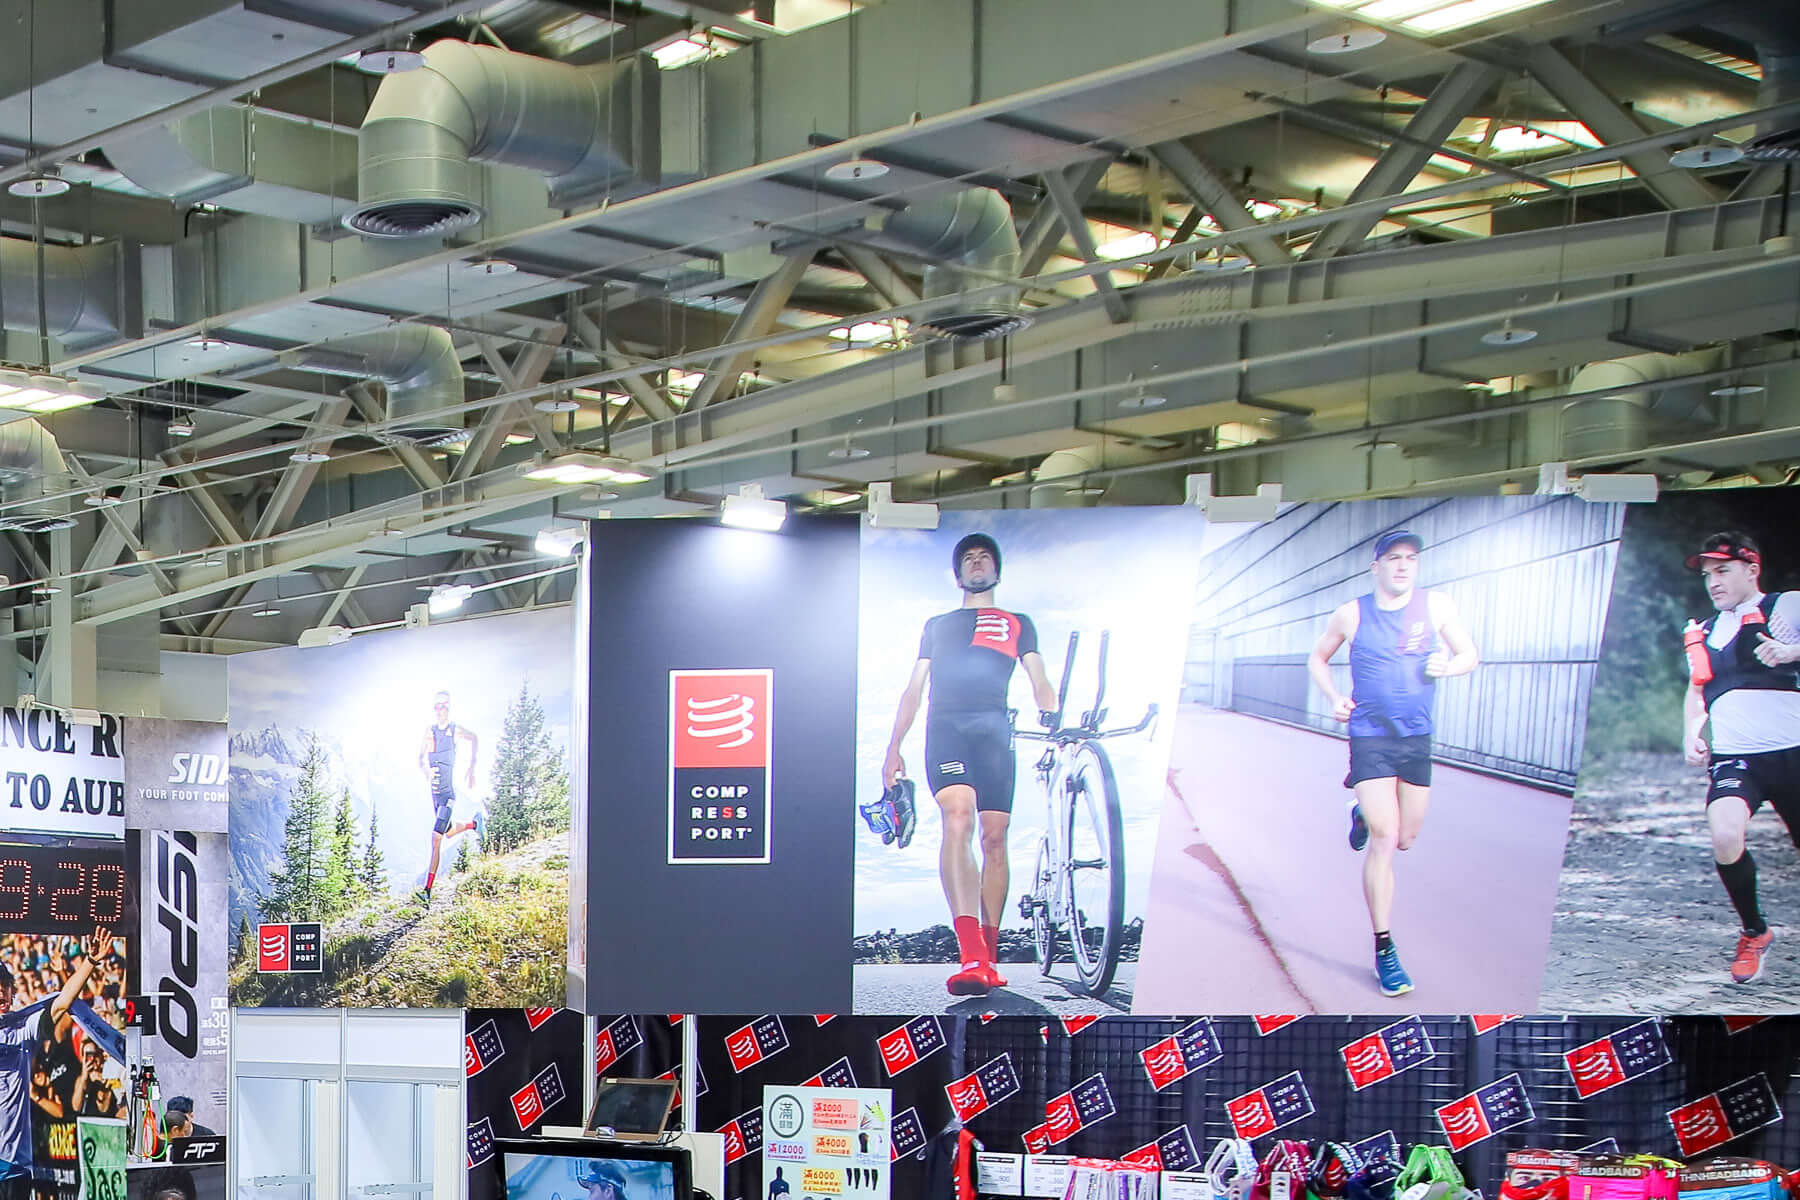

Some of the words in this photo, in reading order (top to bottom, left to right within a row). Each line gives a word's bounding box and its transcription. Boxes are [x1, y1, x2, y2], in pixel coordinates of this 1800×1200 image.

[6, 771, 52, 811] TO
[138, 788, 167, 801] YOUR
[171, 789, 199, 802] FOOT
[690, 786, 749, 799] COMP
[691, 806, 748, 819] RESS
[690, 827, 749, 840] PORT
[183, 1142, 218, 1160] PTP
[1578, 1166, 1642, 1178] HEADBAND
